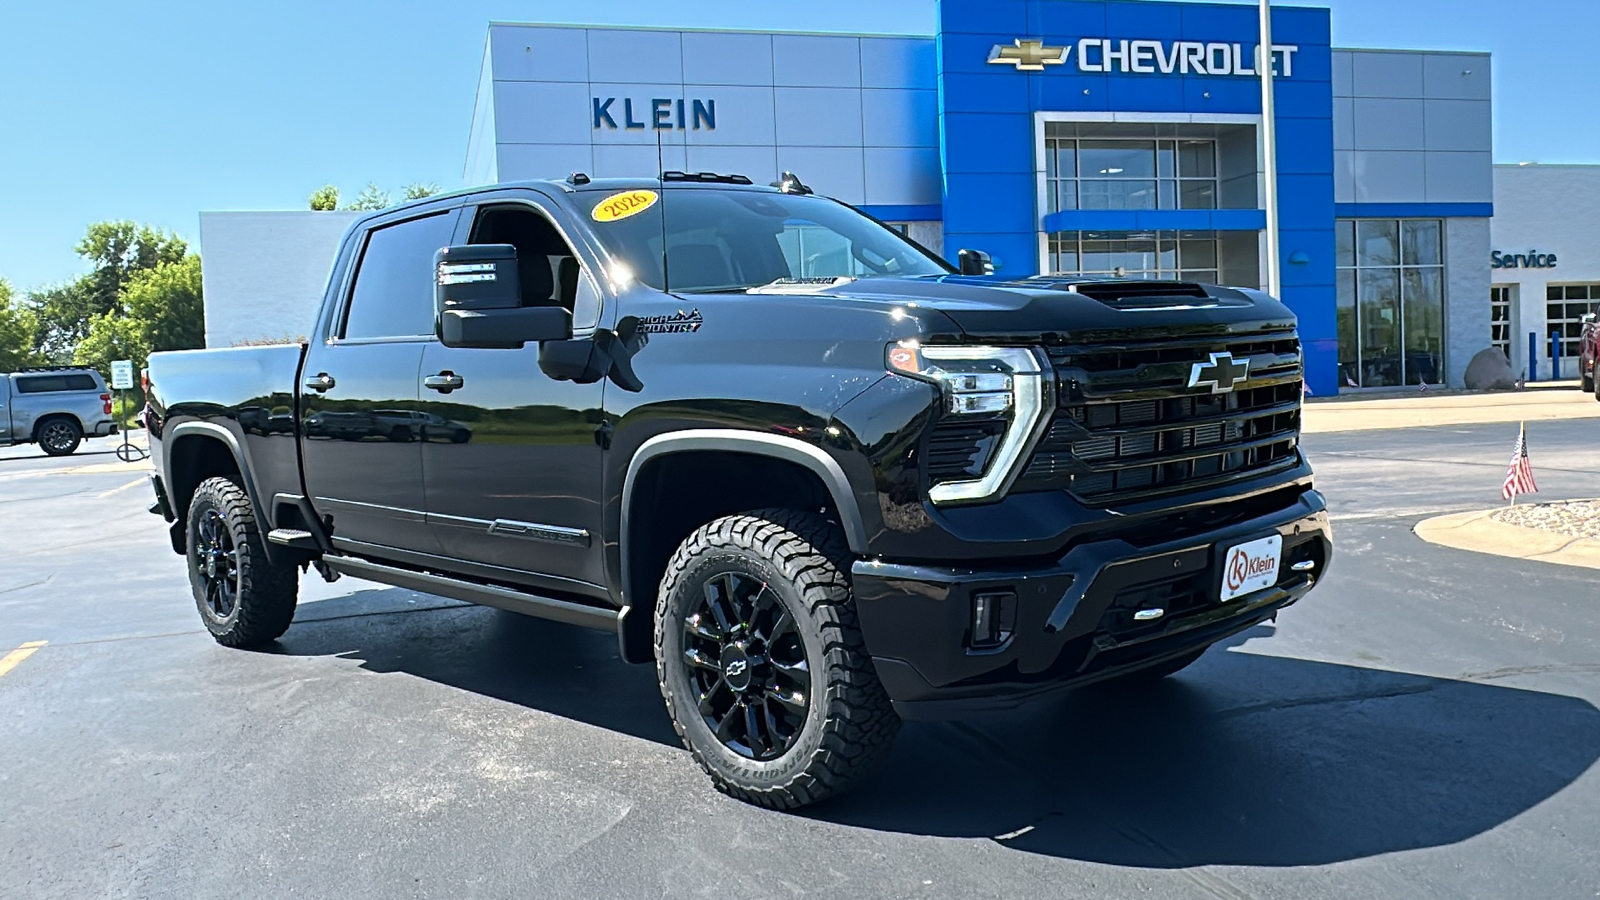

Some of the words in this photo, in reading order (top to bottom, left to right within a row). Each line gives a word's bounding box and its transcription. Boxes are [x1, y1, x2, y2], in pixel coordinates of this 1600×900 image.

[1077, 38, 1298, 77] CHEVROLET
[592, 97, 716, 130] KLEIN
[604, 193, 648, 217] 2026
[1491, 249, 1557, 269] Service
[1248, 554, 1275, 576] Klein
